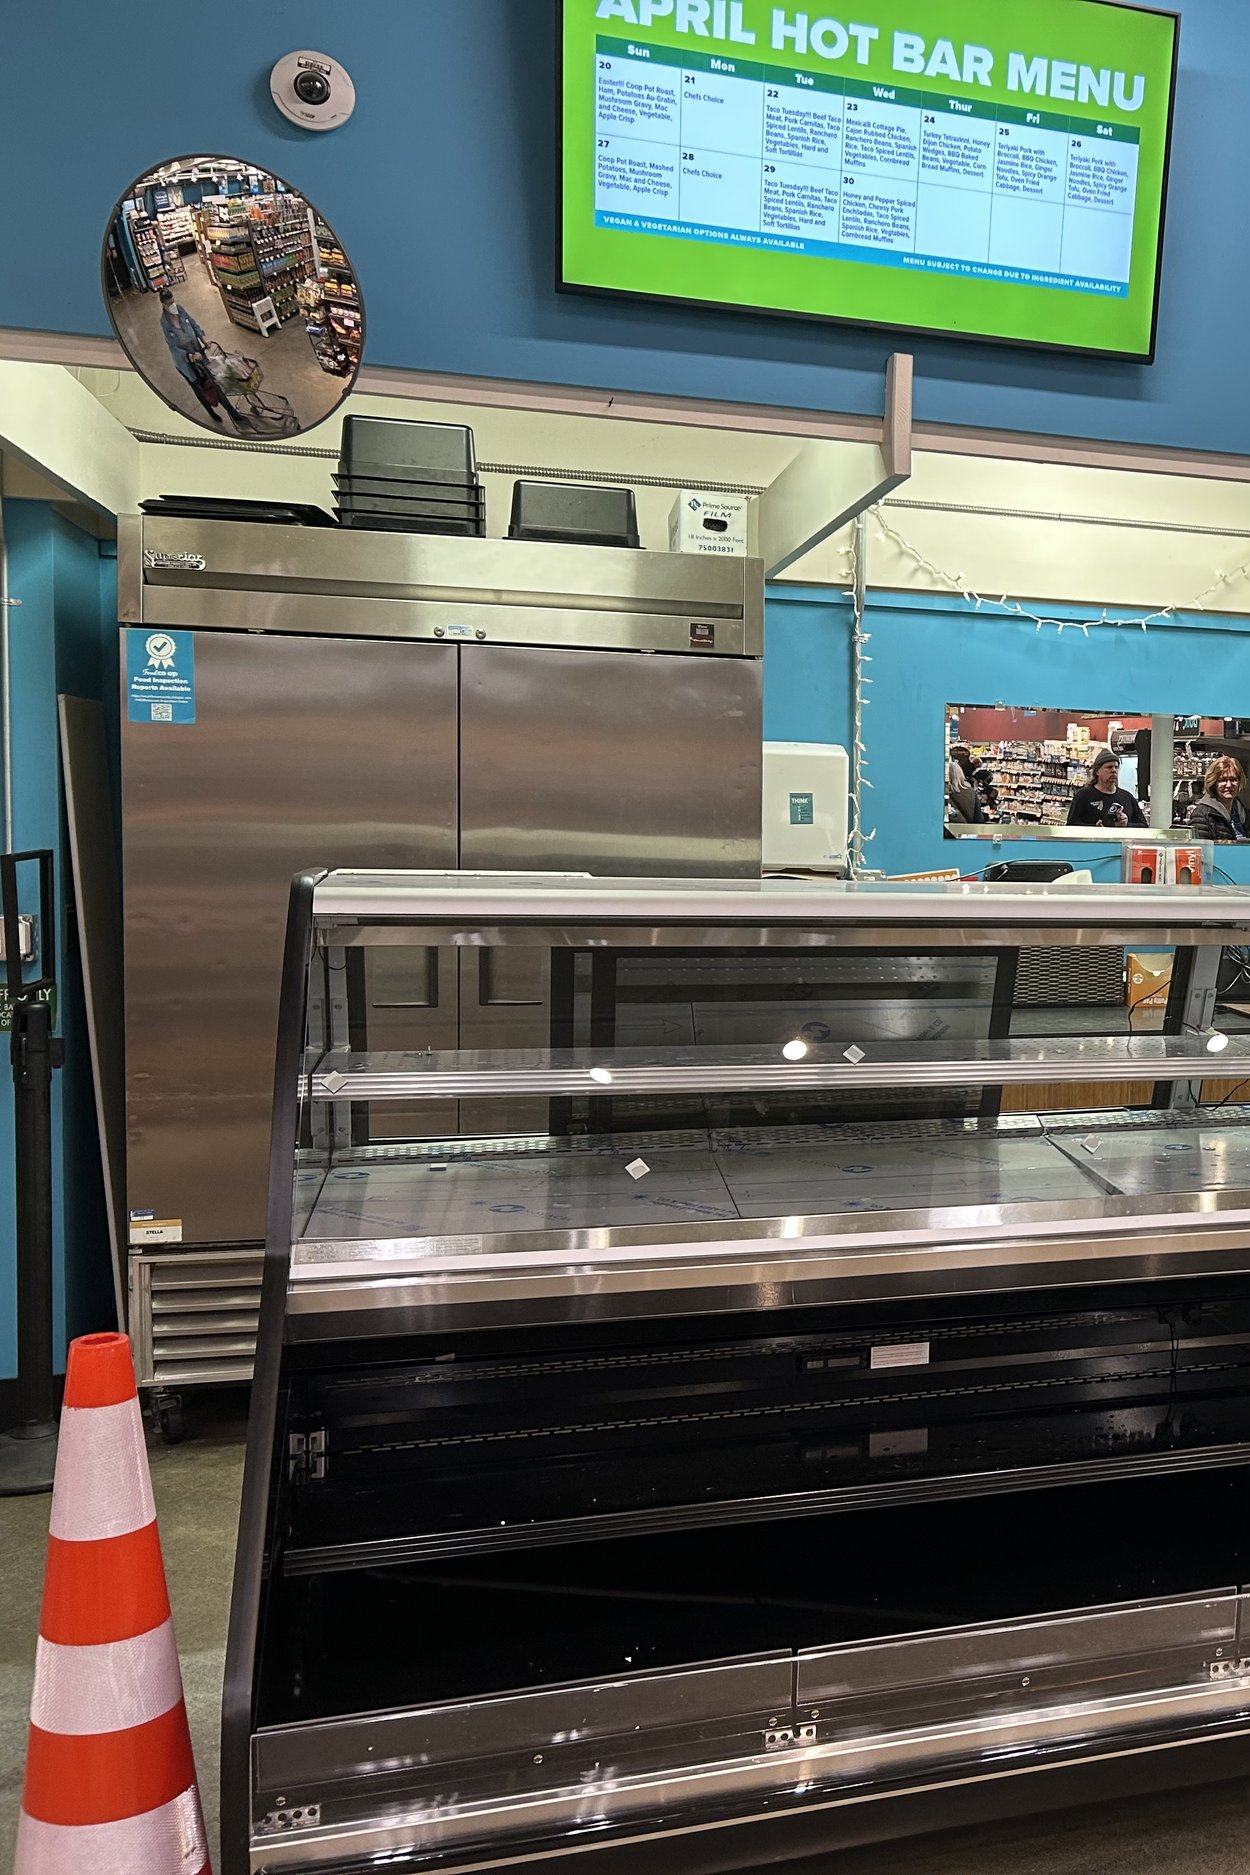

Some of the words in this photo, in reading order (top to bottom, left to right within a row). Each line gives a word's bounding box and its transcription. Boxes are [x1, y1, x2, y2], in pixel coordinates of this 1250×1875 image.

[595, 0, 756, 45] APRIL
[771, 8, 878, 64] HOT
[892, 31, 995, 87] BAR
[1008, 52, 1146, 112] MENU
[598, 60, 611, 70] 20
[684, 74, 695, 84] 21
[598, 85, 615, 96] Ham,
[616, 88, 644, 99] Potatoes
[625, 81, 642, 92] Coop
[644, 84, 654, 92] Pot
[656, 86, 675, 97] Roast,
[626, 44, 650, 58] Sun
[710, 58, 735, 72] Mon
[794, 72, 814, 86] Tue
[872, 86, 895, 99] Wed
[948, 99, 972, 112] Thur
[1025, 112, 1040, 124] Fri
[1095, 124, 1113, 136] Sat
[766, 88, 778, 98] 22
[598, 94, 632, 106] Mushroom
[654, 102, 668, 111] Mac
[683, 90, 701, 100] Chefs
[702, 94, 724, 104] Choice
[598, 102, 610, 111] and
[611, 104, 637, 116] Cheese,
[638, 108, 672, 122] Vegetable,
[766, 104, 780, 113] Taco
[812, 112, 826, 120] Beef
[827, 114, 841, 123] Taco
[846, 102, 858, 111] 23
[598, 110, 617, 122] Apple
[618, 114, 635, 125] Crisp
[765, 112, 783, 123] Meat,
[784, 115, 798, 124] Pork
[826, 122, 840, 131] Taco
[923, 114, 935, 124] 24
[765, 120, 786, 132] Spiced
[809, 127, 837, 138] Ranchero
[998, 127, 1009, 136] 25
[597, 138, 609, 148] 27
[765, 129, 786, 139] Beans,
[787, 132, 810, 144] Spanish
[811, 136, 826, 146] Rice,
[1070, 139, 1081, 148] 26
[764, 137, 800, 150] Vegetables,
[801, 142, 816, 151] Hard
[816, 145, 828, 153] and
[764, 145, 777, 153] Soft
[597, 154, 615, 166] Coop
[616, 157, 627, 165] Pot
[628, 159, 647, 169] Roast,
[648, 162, 673, 172] Mashed
[682, 152, 694, 161] 28
[597, 163, 627, 175] Potatoes,
[628, 167, 662, 179] Mushroom
[682, 167, 700, 176] Chefs
[701, 170, 722, 179] Choice
[763, 164, 775, 173] 29
[619, 174, 632, 182] Mac
[633, 176, 646, 184] and
[646, 178, 672, 189] Cheese,
[842, 176, 854, 185] 30
[597, 179, 631, 193] Vegetable,
[632, 184, 651, 195] Apple
[652, 187, 668, 198] Crisp
[842, 191, 862, 202] Honey
[874, 195, 895, 206] Pepper
[896, 198, 916, 209] Spiced
[842, 199, 867, 210] Chicken,
[868, 202, 889, 214] Cheesy
[890, 206, 904, 214] Pork
[863, 217, 890, 227] Ranchero
[891, 221, 910, 231] Beans,
[876, 211, 889, 219] Taco
[890, 213, 909, 224] Spiced
[602, 215, 632, 226] VEGAN
[640, 220, 692, 234] VEGETARIAN
[692, 227, 729, 239] OPTIONS
[729, 232, 761, 244] ALWAYS
[762, 237, 805, 250] AVAILABLE
[840, 230, 871, 240] Cornbread
[841, 222, 864, 233] Spanish
[865, 226, 879, 235] Rice,
[902, 256, 925, 266] MENU
[926, 259, 959, 270] SUBJECT
[960, 264, 971, 272] TO
[971, 265, 1003, 276] CHANGE
[1003, 270, 1019, 278] DUE
[1020, 272, 1030, 280] TO
[1031, 273, 1074, 286] INGREDIENT
[1074, 279, 1121, 292] AVAILABILITY
[698, 544, 734, 552] 75003831
[1186, 850, 1196, 873] vinyl
